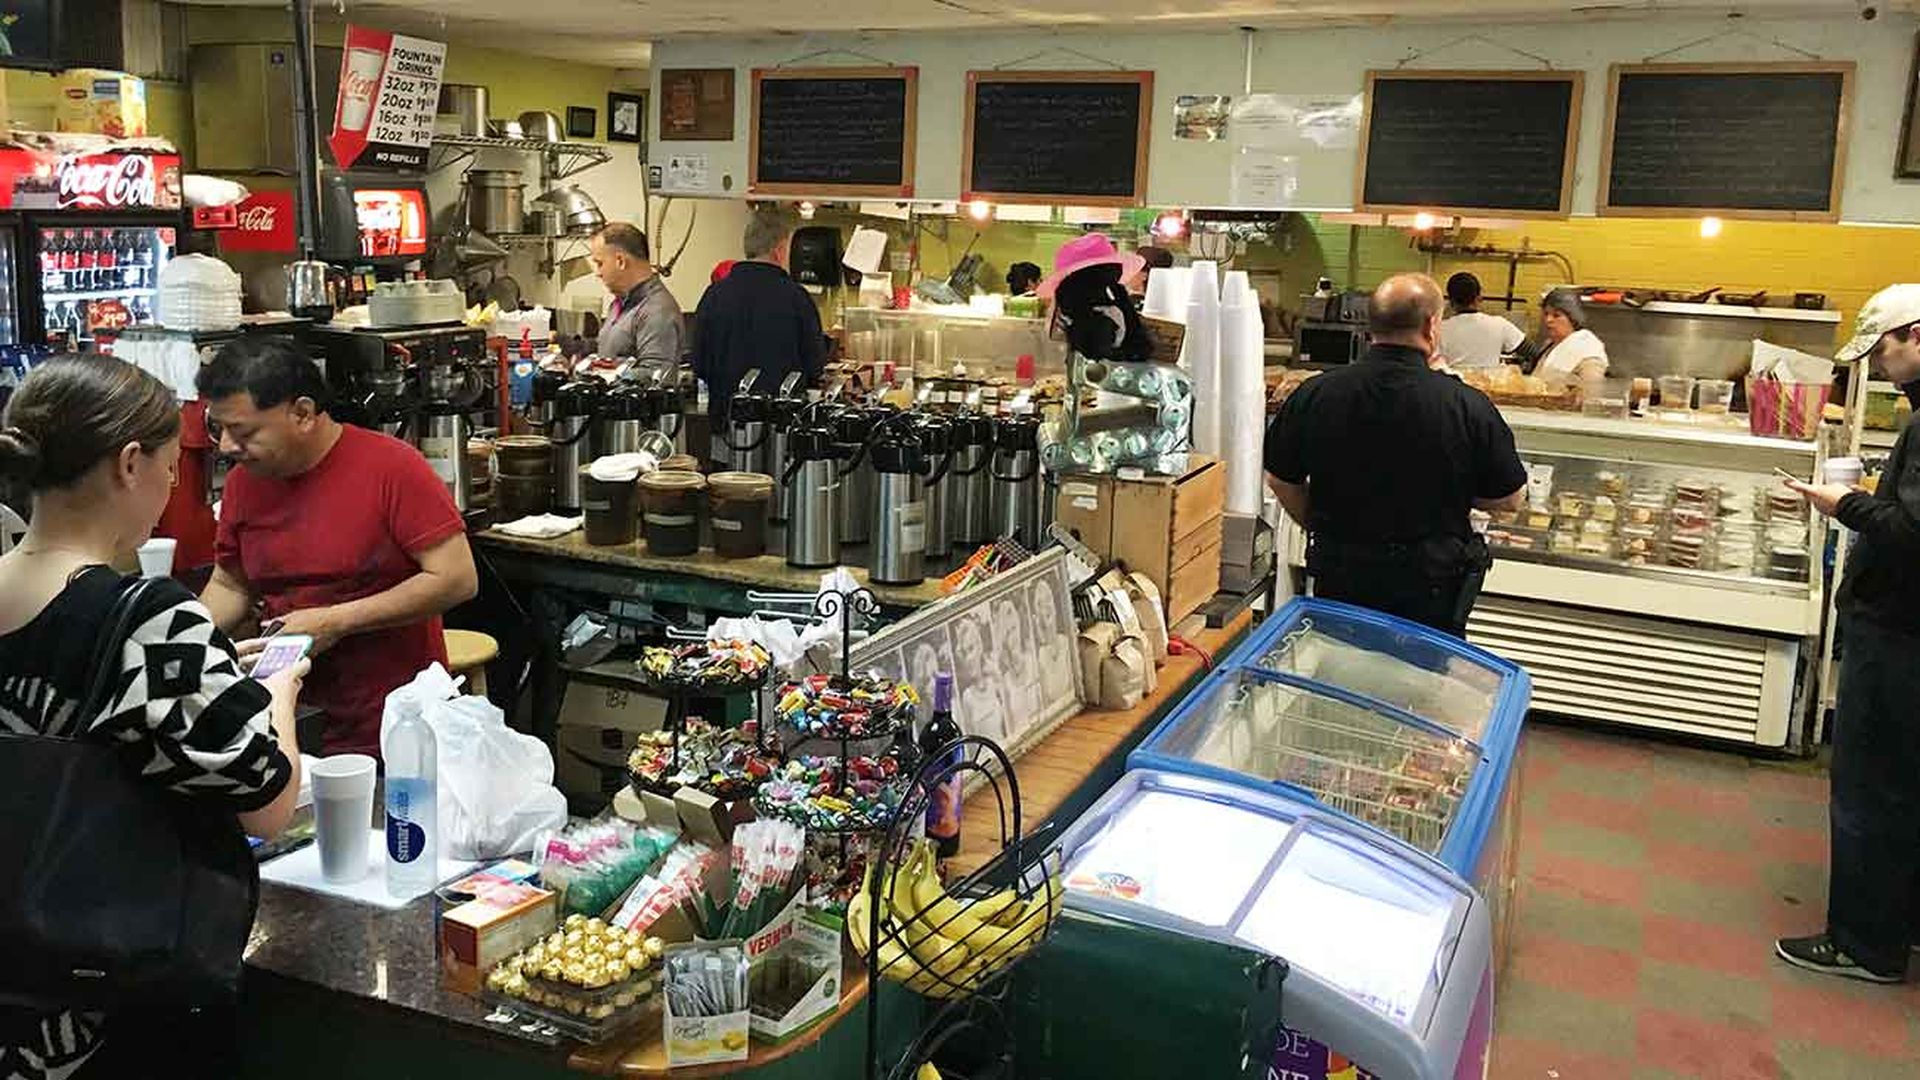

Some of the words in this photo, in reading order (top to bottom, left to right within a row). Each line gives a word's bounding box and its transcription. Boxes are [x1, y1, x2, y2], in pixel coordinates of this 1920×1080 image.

[392, 48, 442, 65] FOUNTAIN
[397, 61, 433, 76] DRINKS
[376, 152, 389, 162] NO
